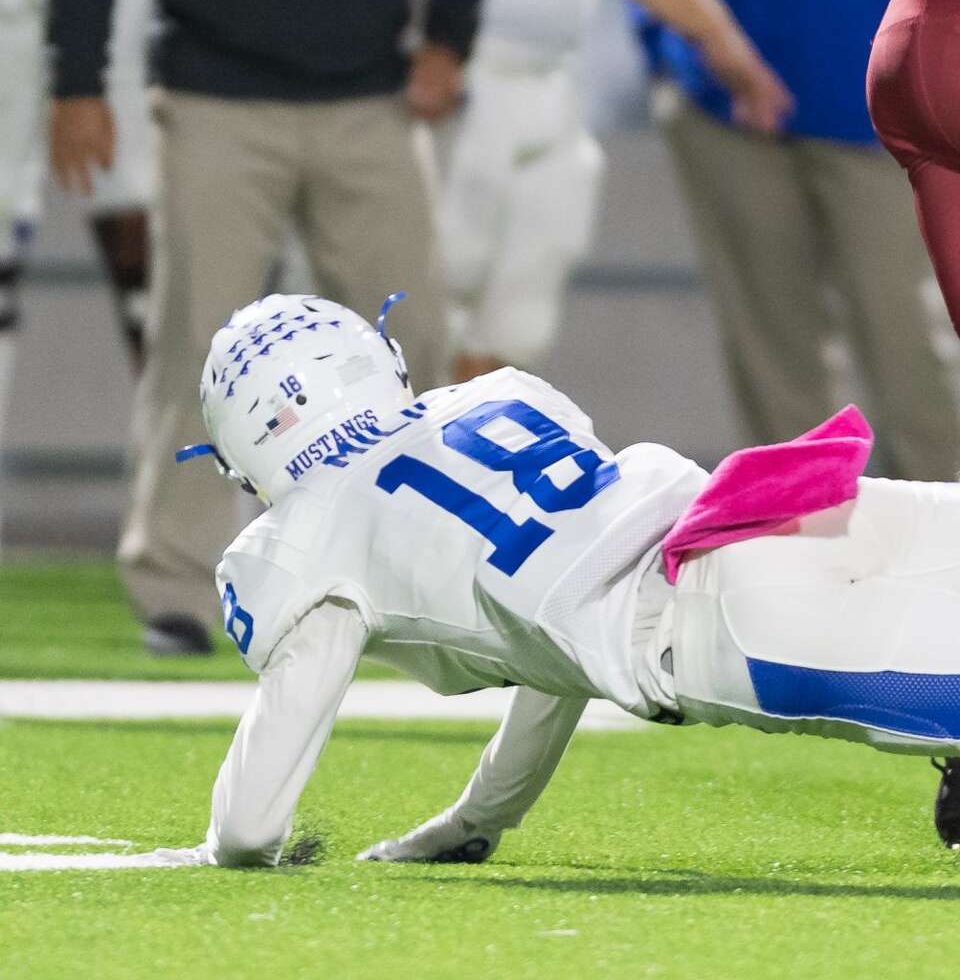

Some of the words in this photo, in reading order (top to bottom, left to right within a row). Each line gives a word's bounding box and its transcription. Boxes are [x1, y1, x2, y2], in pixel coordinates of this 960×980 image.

[279, 375, 302, 399] 18
[284, 409, 379, 482] MUSTANGS
[375, 399, 622, 578] 18
